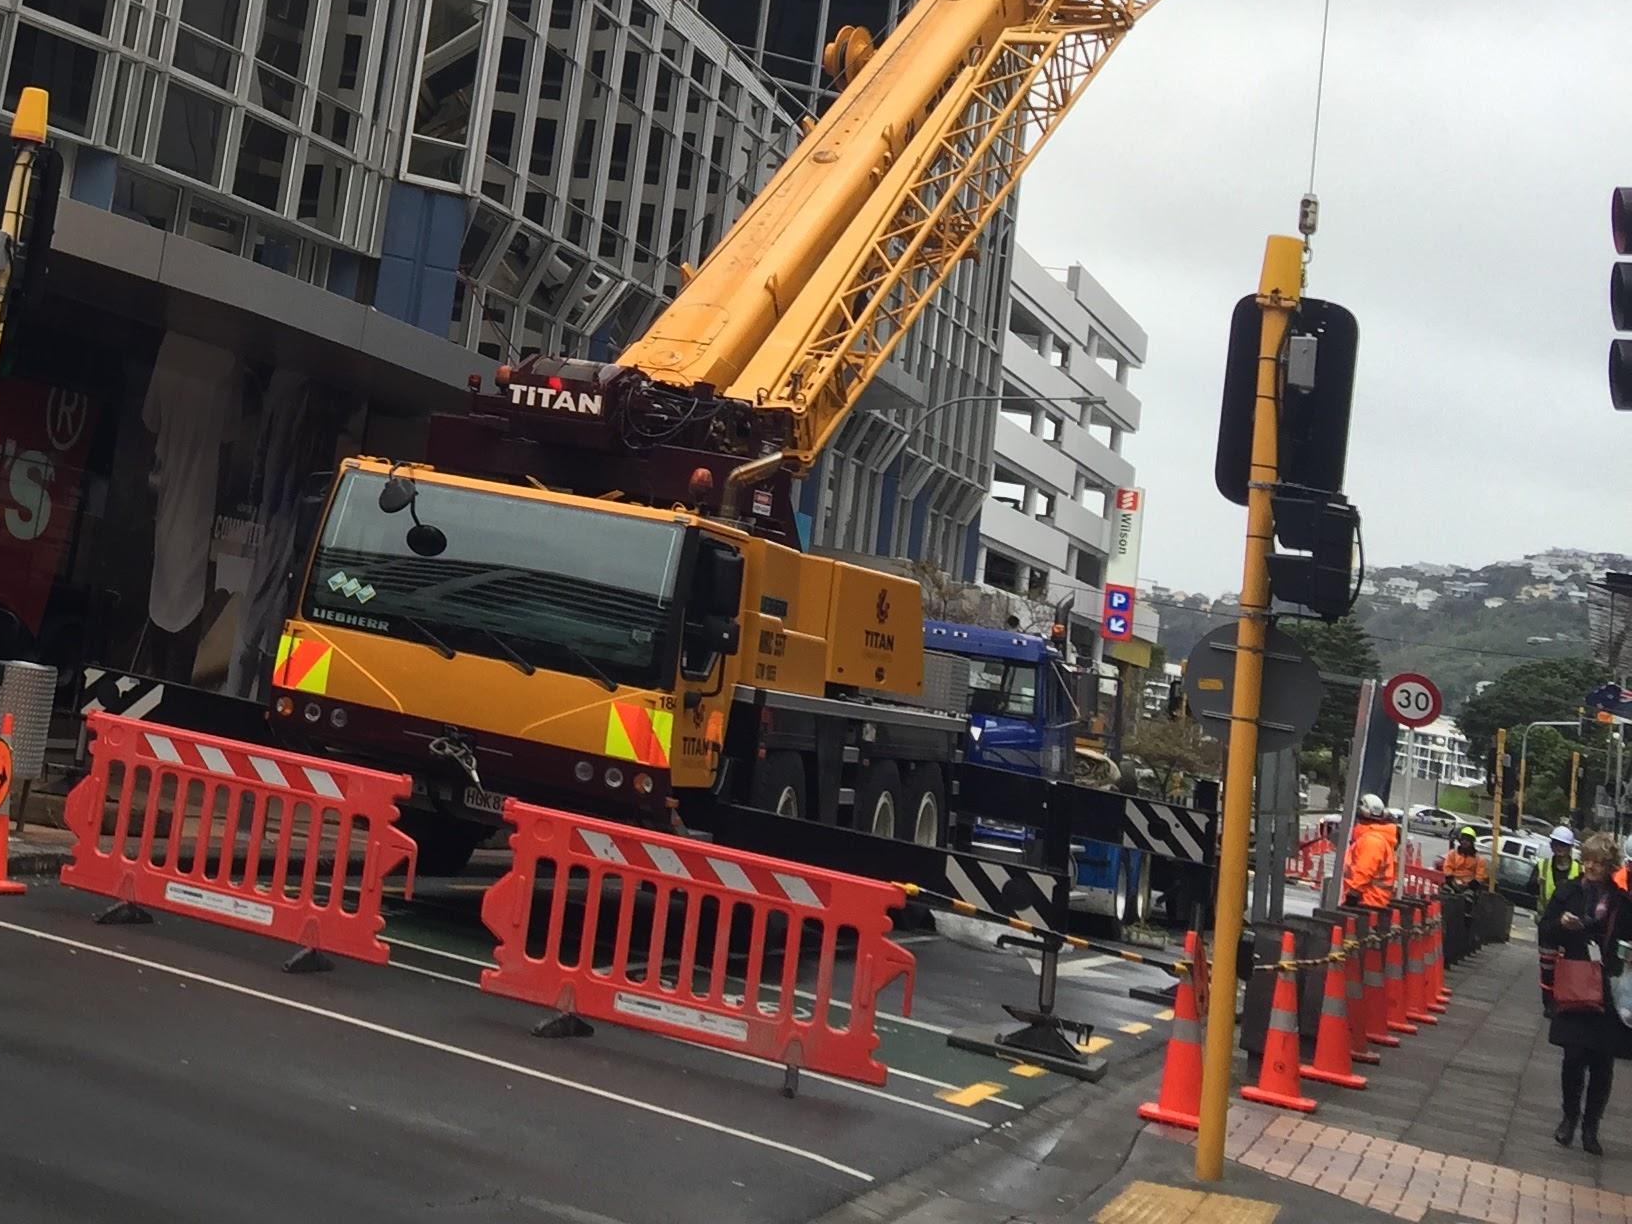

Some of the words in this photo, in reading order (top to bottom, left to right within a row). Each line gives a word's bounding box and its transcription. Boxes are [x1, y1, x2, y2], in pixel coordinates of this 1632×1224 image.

[509, 384, 602, 415] TITAN
[1118, 513, 1132, 555] Wilson
[1112, 592, 1126, 608] P
[313, 608, 389, 631] LIEBHERR
[864, 629, 895, 652] TITAN
[1398, 689, 1429, 712] 30
